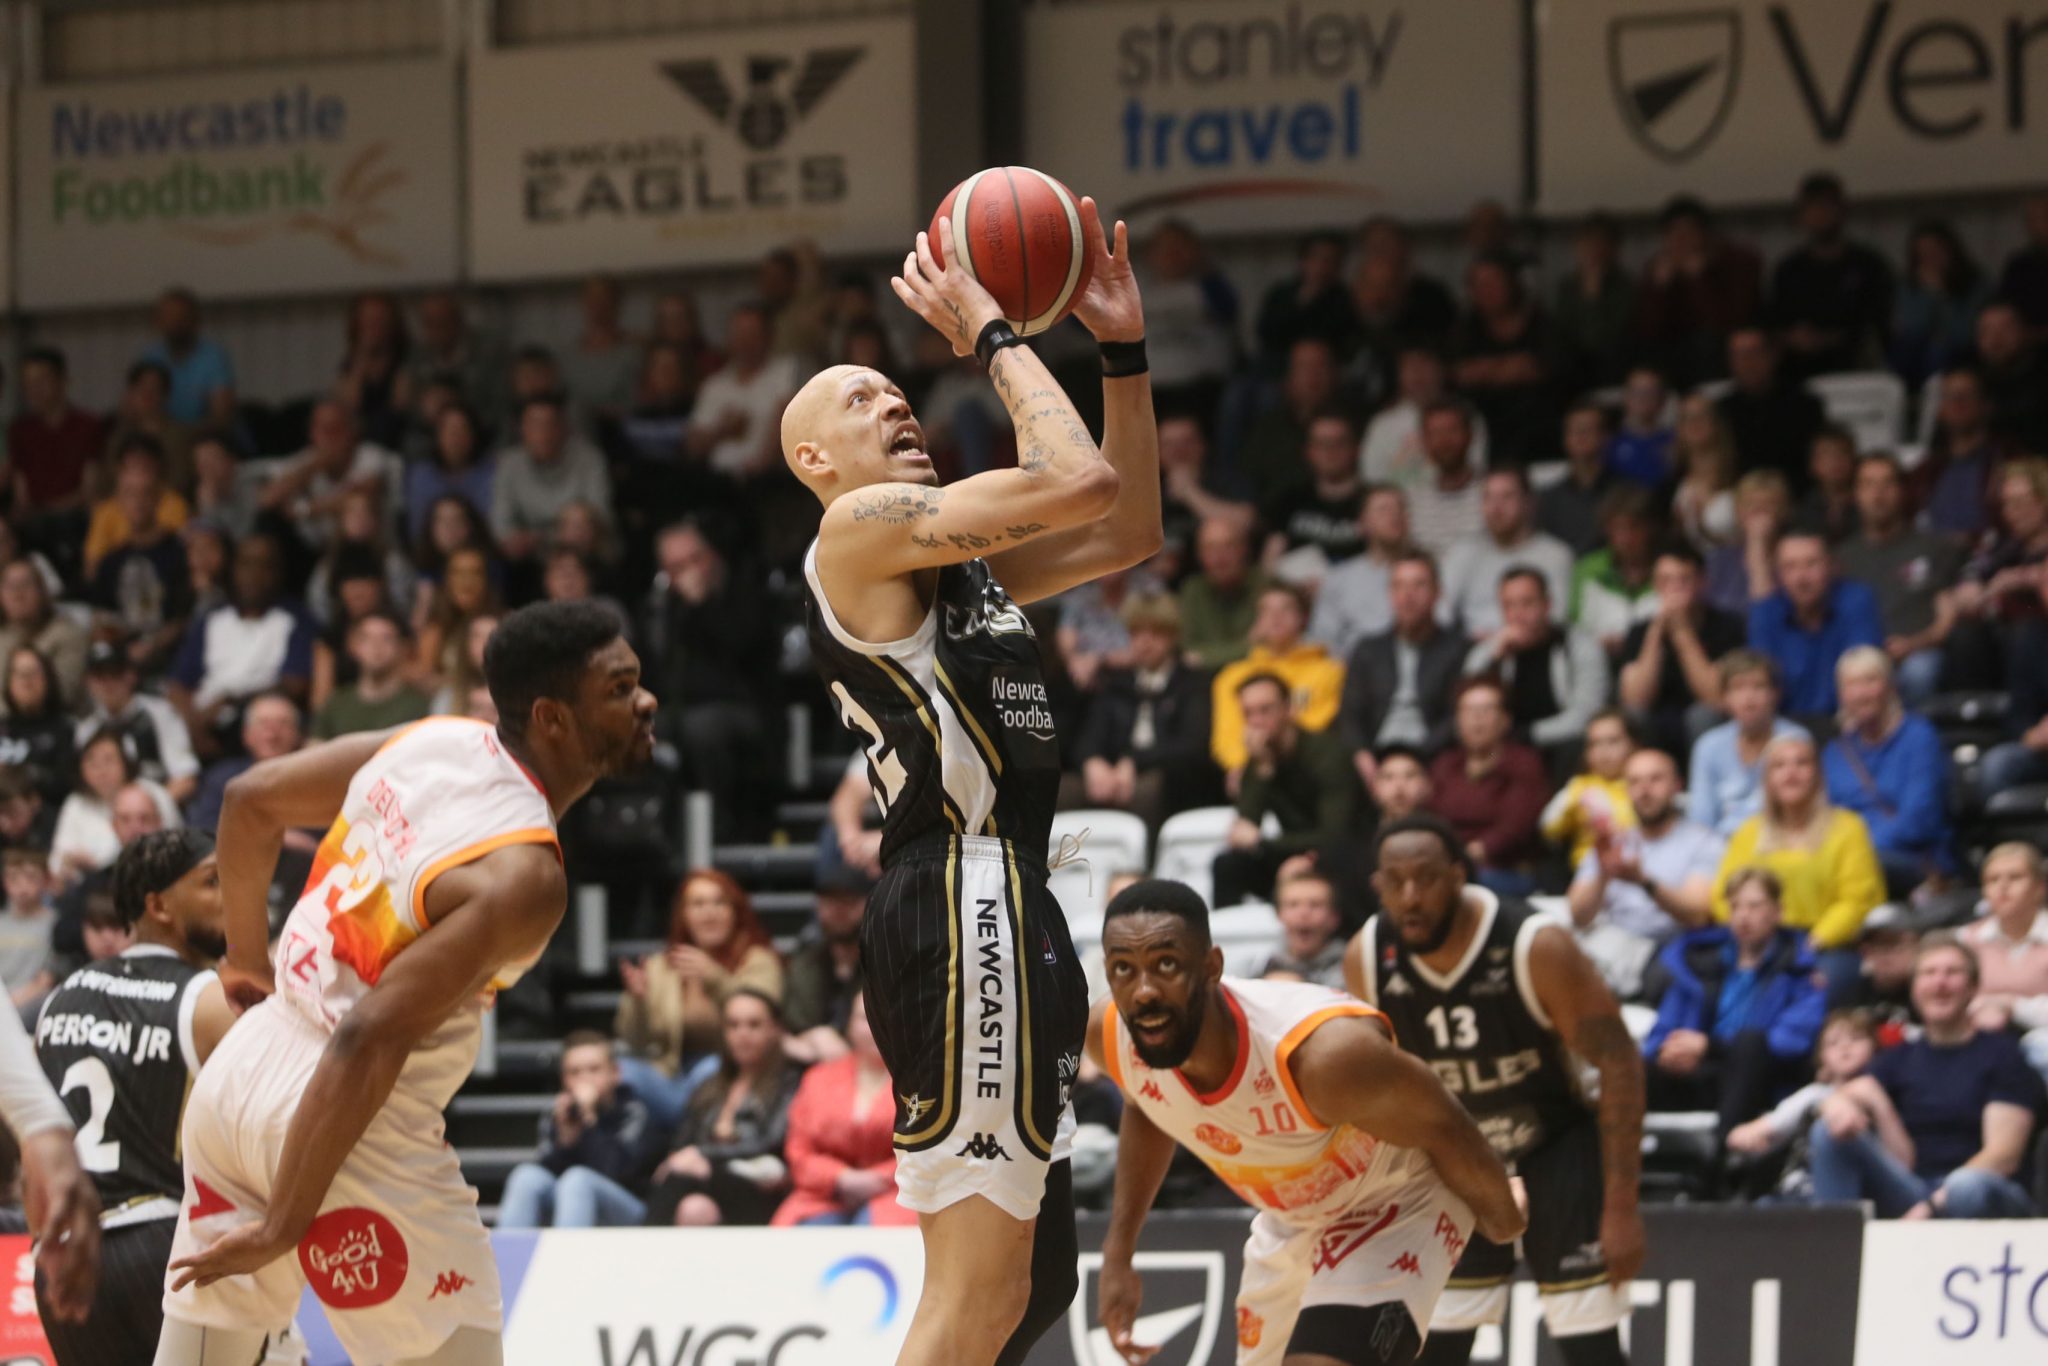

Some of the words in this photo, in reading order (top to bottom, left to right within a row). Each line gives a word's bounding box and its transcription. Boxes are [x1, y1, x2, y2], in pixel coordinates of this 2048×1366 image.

[1117, 0, 1403, 88] stanley
[54, 84, 346, 157] Newcastle
[1123, 83, 1361, 170] travel
[54, 152, 327, 225] Foodbank
[524, 155, 849, 224] EAGLES
[976, 898, 1003, 1099] NEWCASTLE
[1425, 1005, 1479, 1049] 13
[37, 1012, 133, 1055] PERSON
[133, 1024, 172, 1066] JR
[59, 1057, 120, 1172] 2
[1249, 1101, 1297, 1136] 10
[309, 1222, 384, 1275] Good
